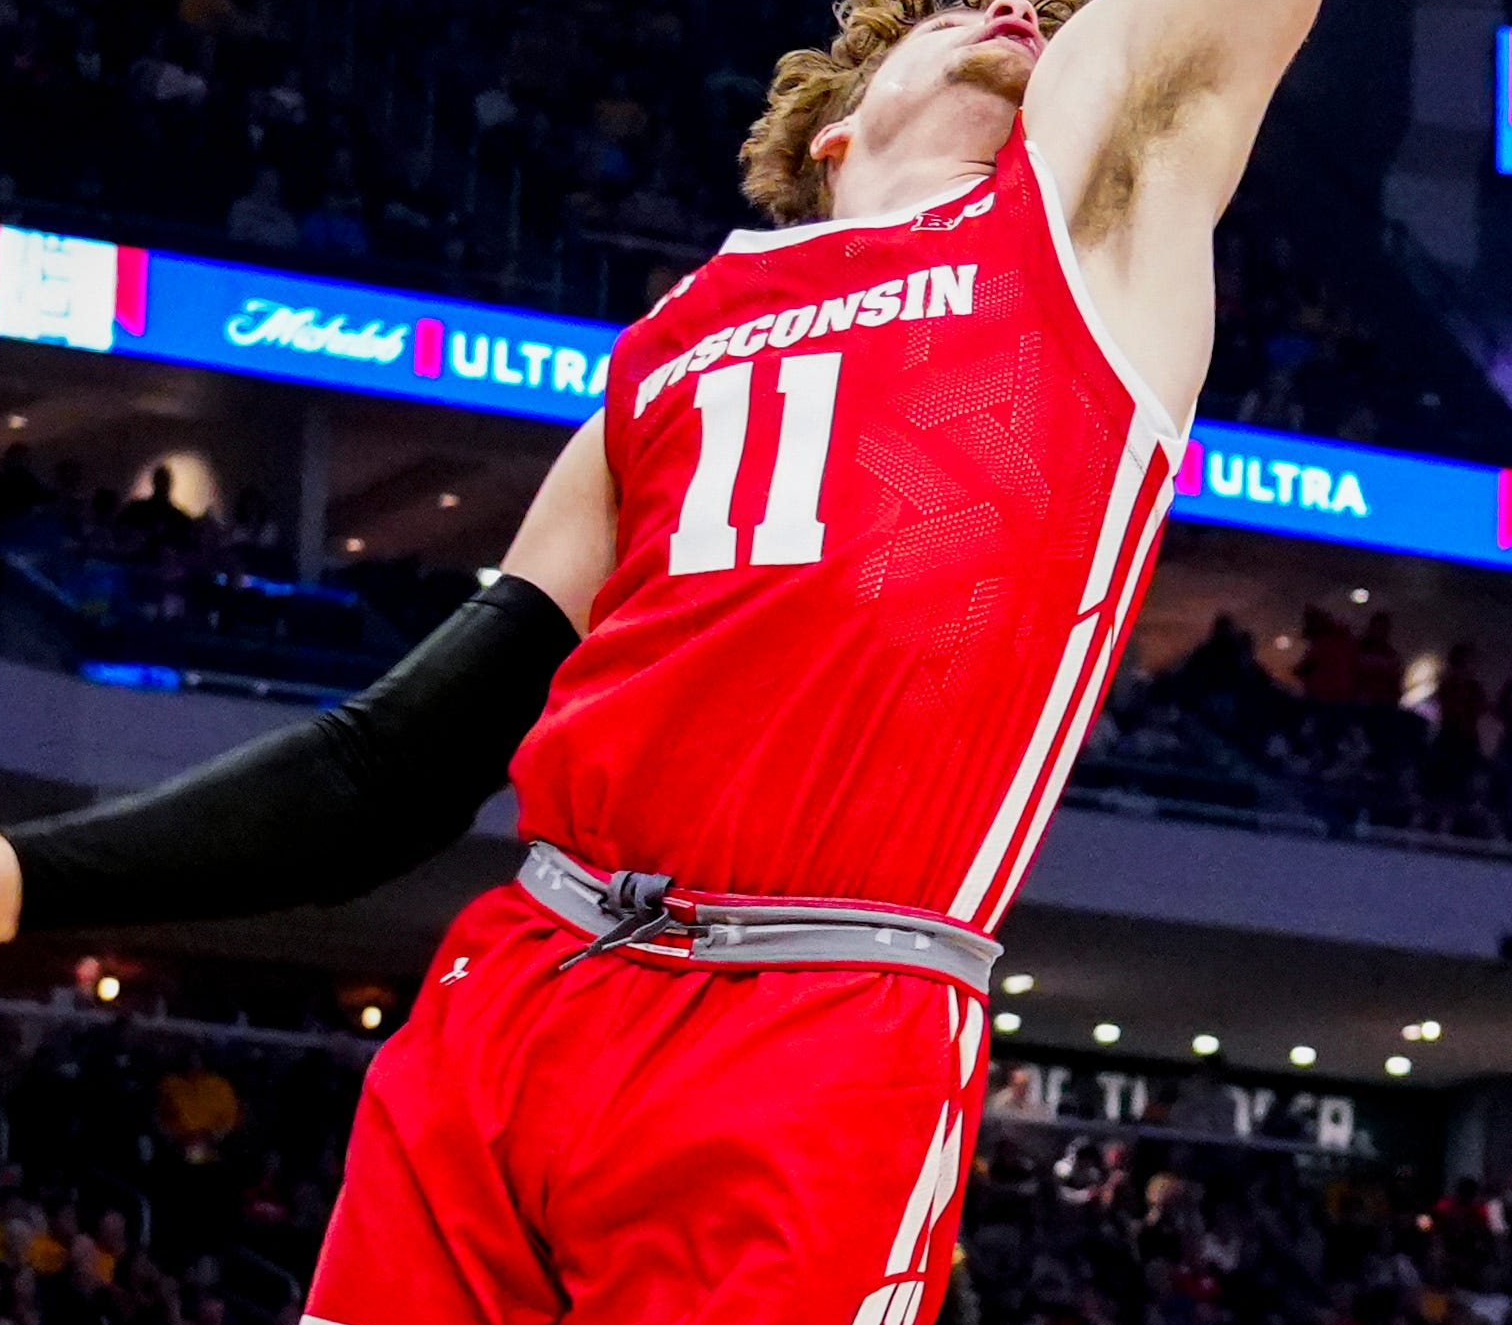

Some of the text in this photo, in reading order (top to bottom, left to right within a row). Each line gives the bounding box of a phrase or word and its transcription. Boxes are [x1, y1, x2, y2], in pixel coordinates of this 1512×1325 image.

[633, 264, 979, 420] WISCONSIN
[668, 352, 843, 577] 11
[1208, 451, 1371, 516] ULTRA
